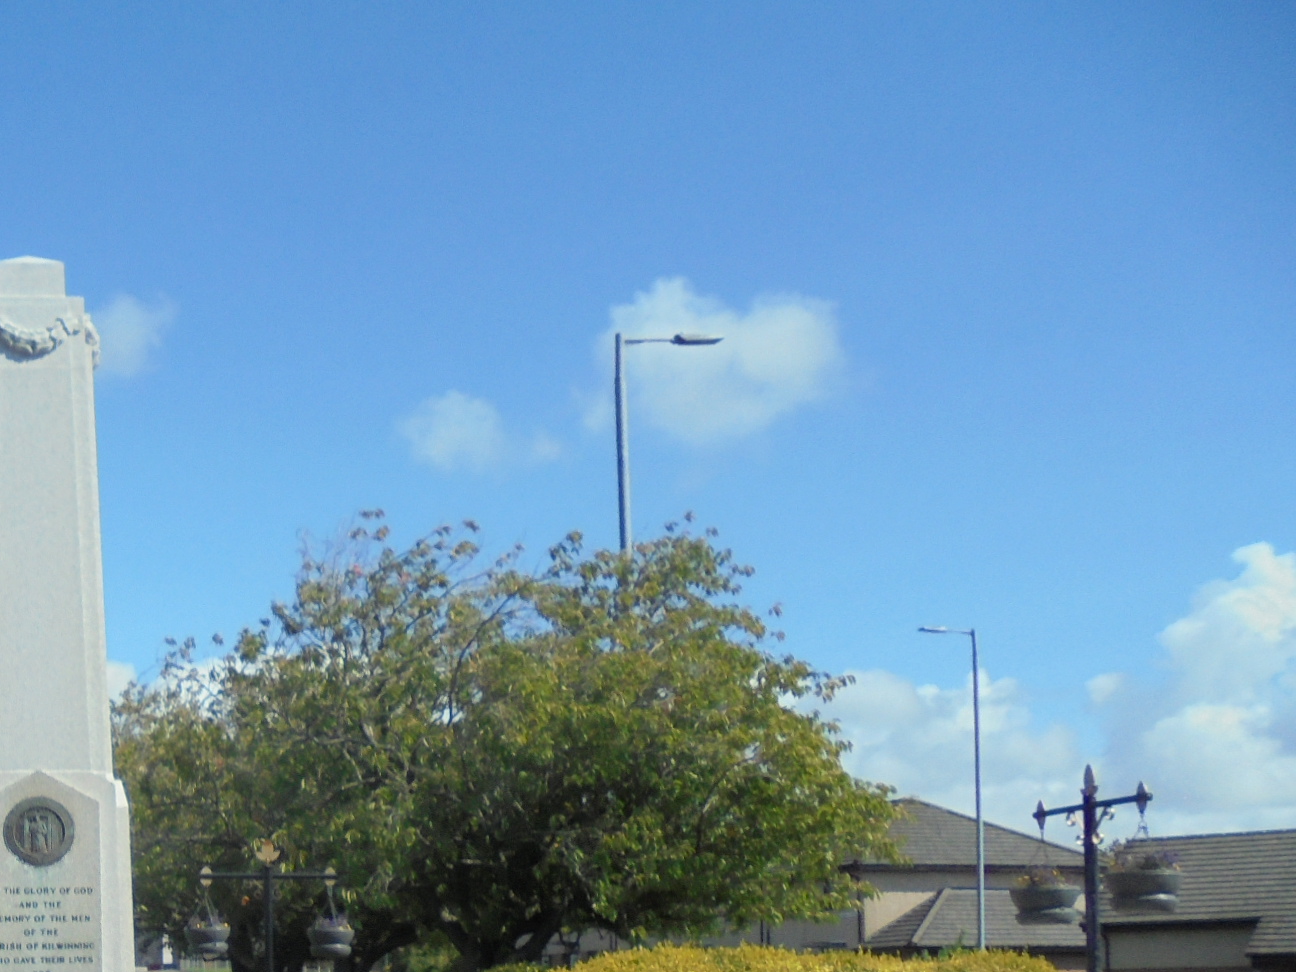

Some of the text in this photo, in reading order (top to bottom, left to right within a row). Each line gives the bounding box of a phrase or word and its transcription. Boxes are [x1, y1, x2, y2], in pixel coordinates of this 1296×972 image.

[4, 887, 20, 895] THE
[24, 887, 56, 895] GLORY
[60, 887, 71, 895] OF
[74, 887, 93, 895] GOD
[26, 942, 38, 950] OF
[42, 942, 95, 950] KILWINNING
[14, 956, 35, 964] GAVE
[40, 956, 65, 964] THEIR
[69, 956, 93, 964] LIVES
